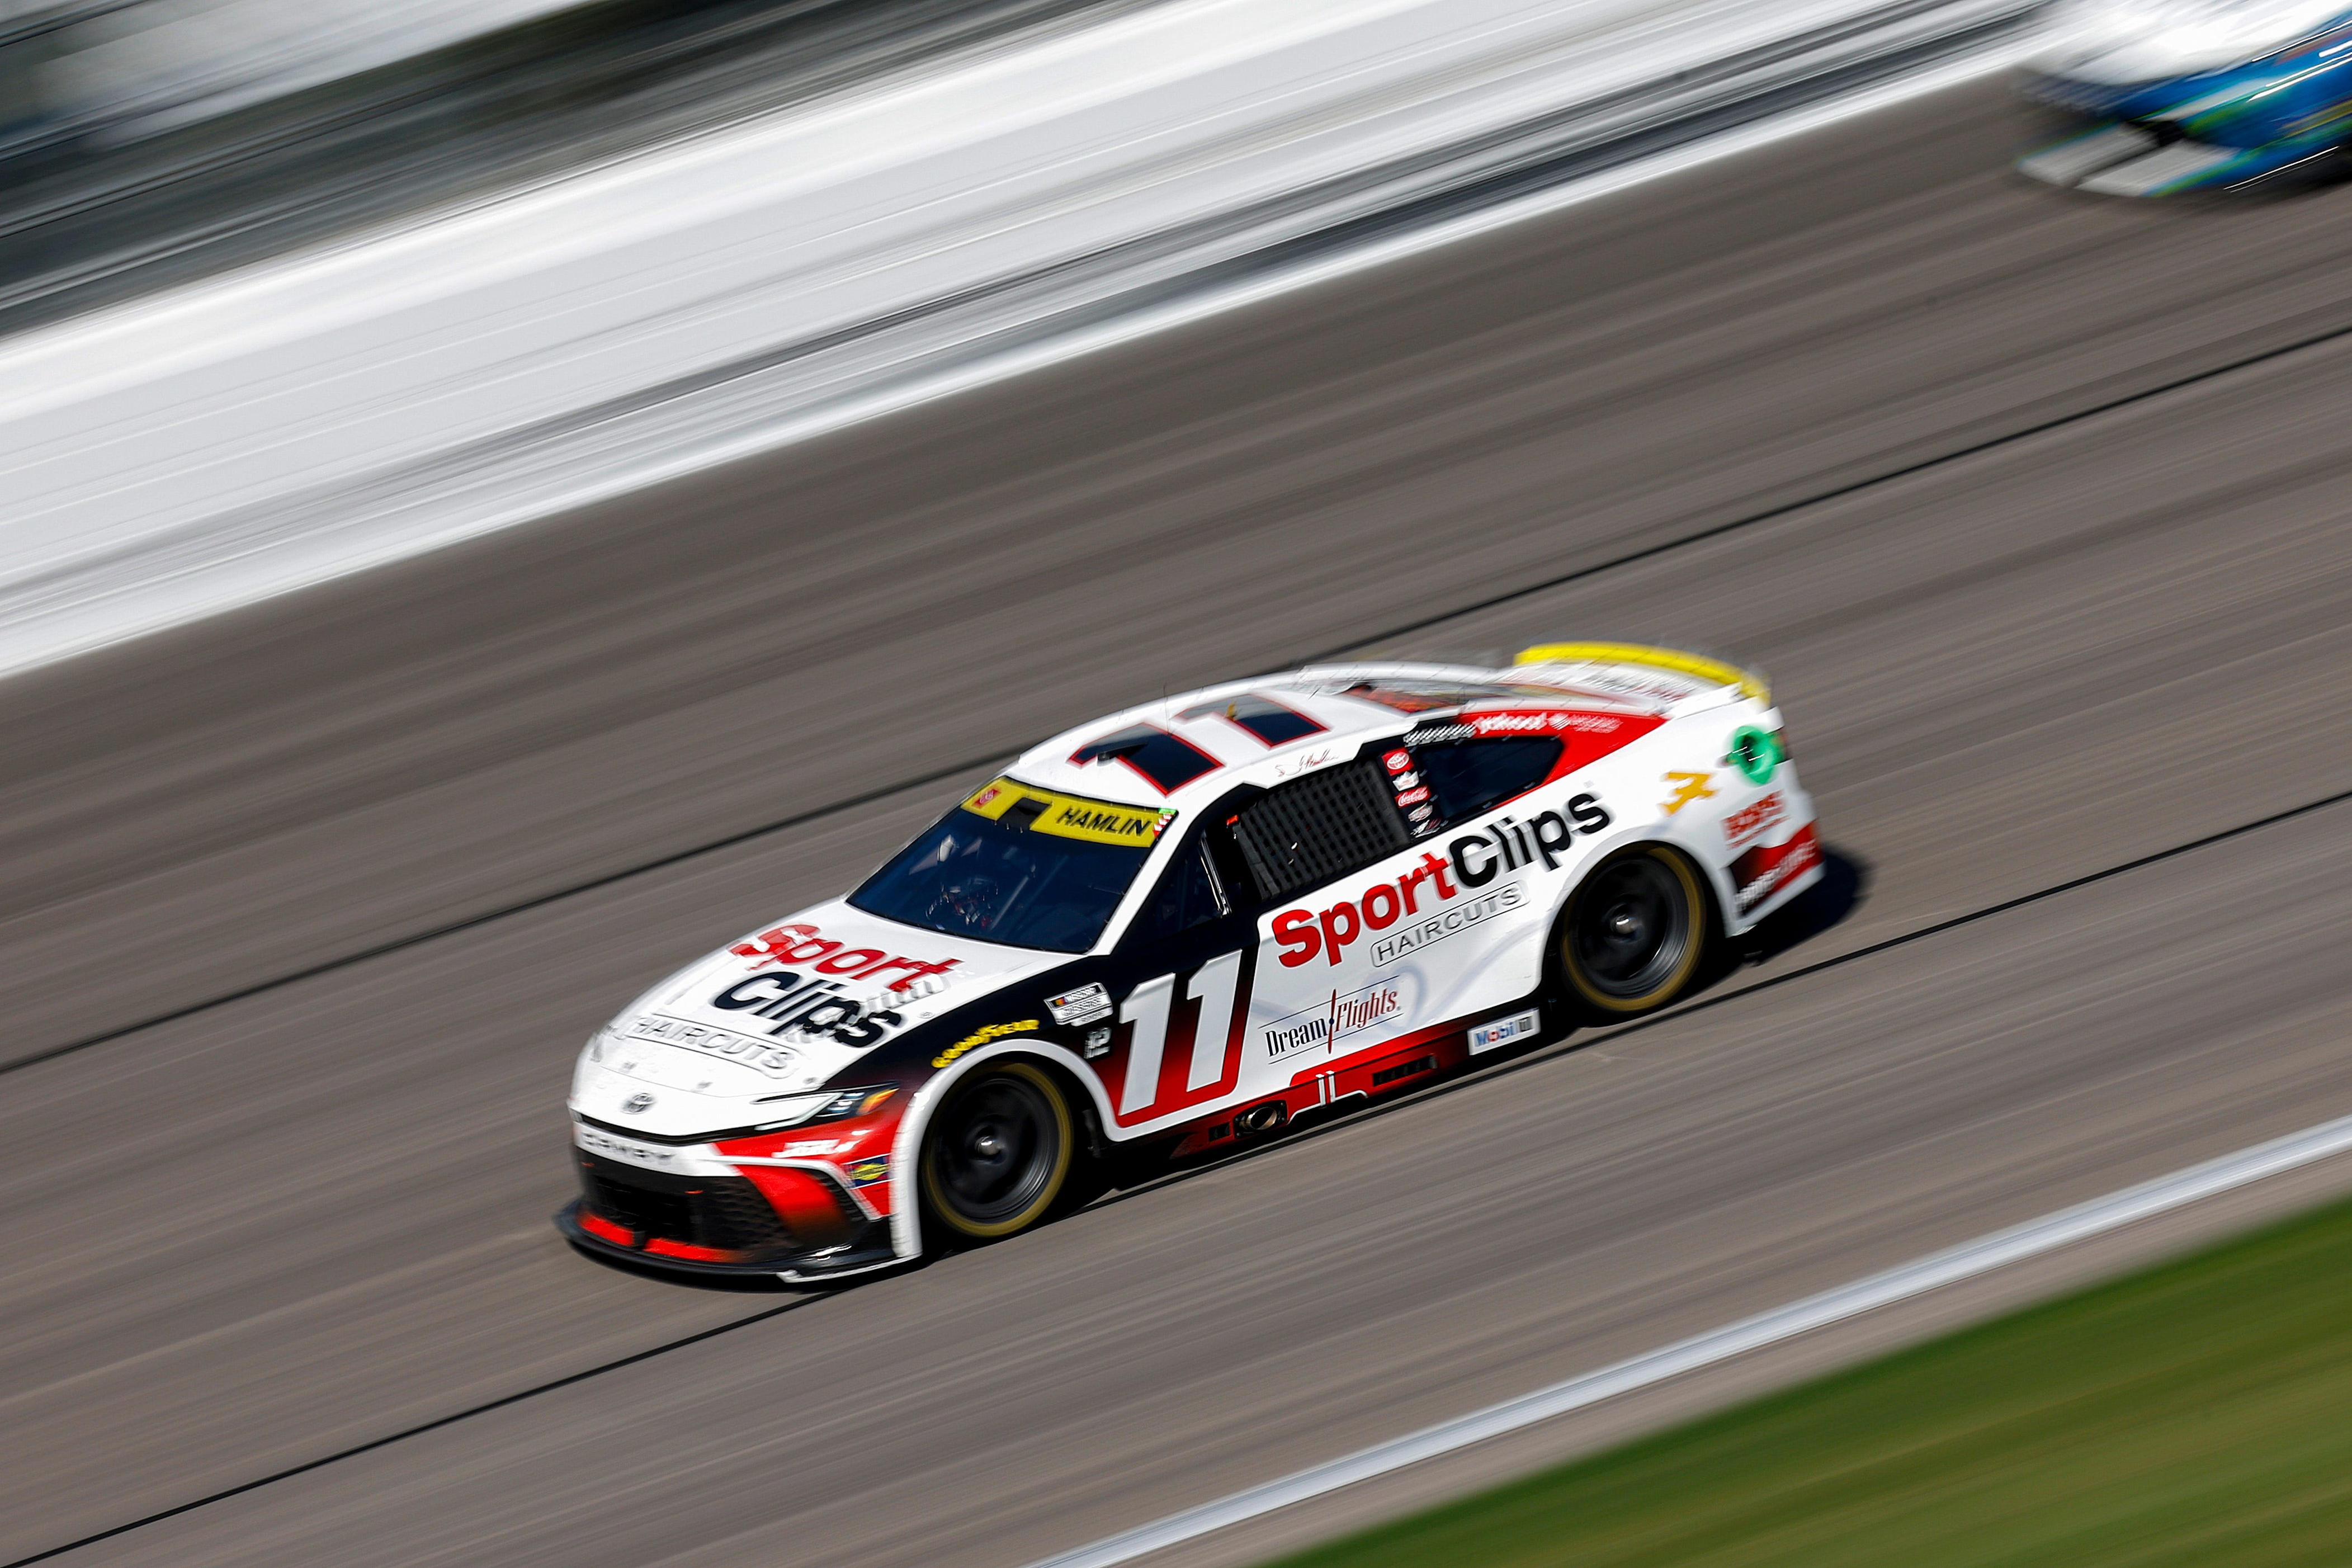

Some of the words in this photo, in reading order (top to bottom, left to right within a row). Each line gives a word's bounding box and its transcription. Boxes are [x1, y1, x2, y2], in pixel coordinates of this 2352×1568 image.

[1056, 805, 1153, 837] HAMLIN
[730, 924, 965, 993] Sport
[1377, 887, 1522, 962] HAIRCUTS
[632, 1017, 795, 1070] HAIRCUTS
[714, 971, 903, 1047] Clips
[1119, 948, 1243, 1117] 11
[1265, 1018, 1329, 1057] Dream
